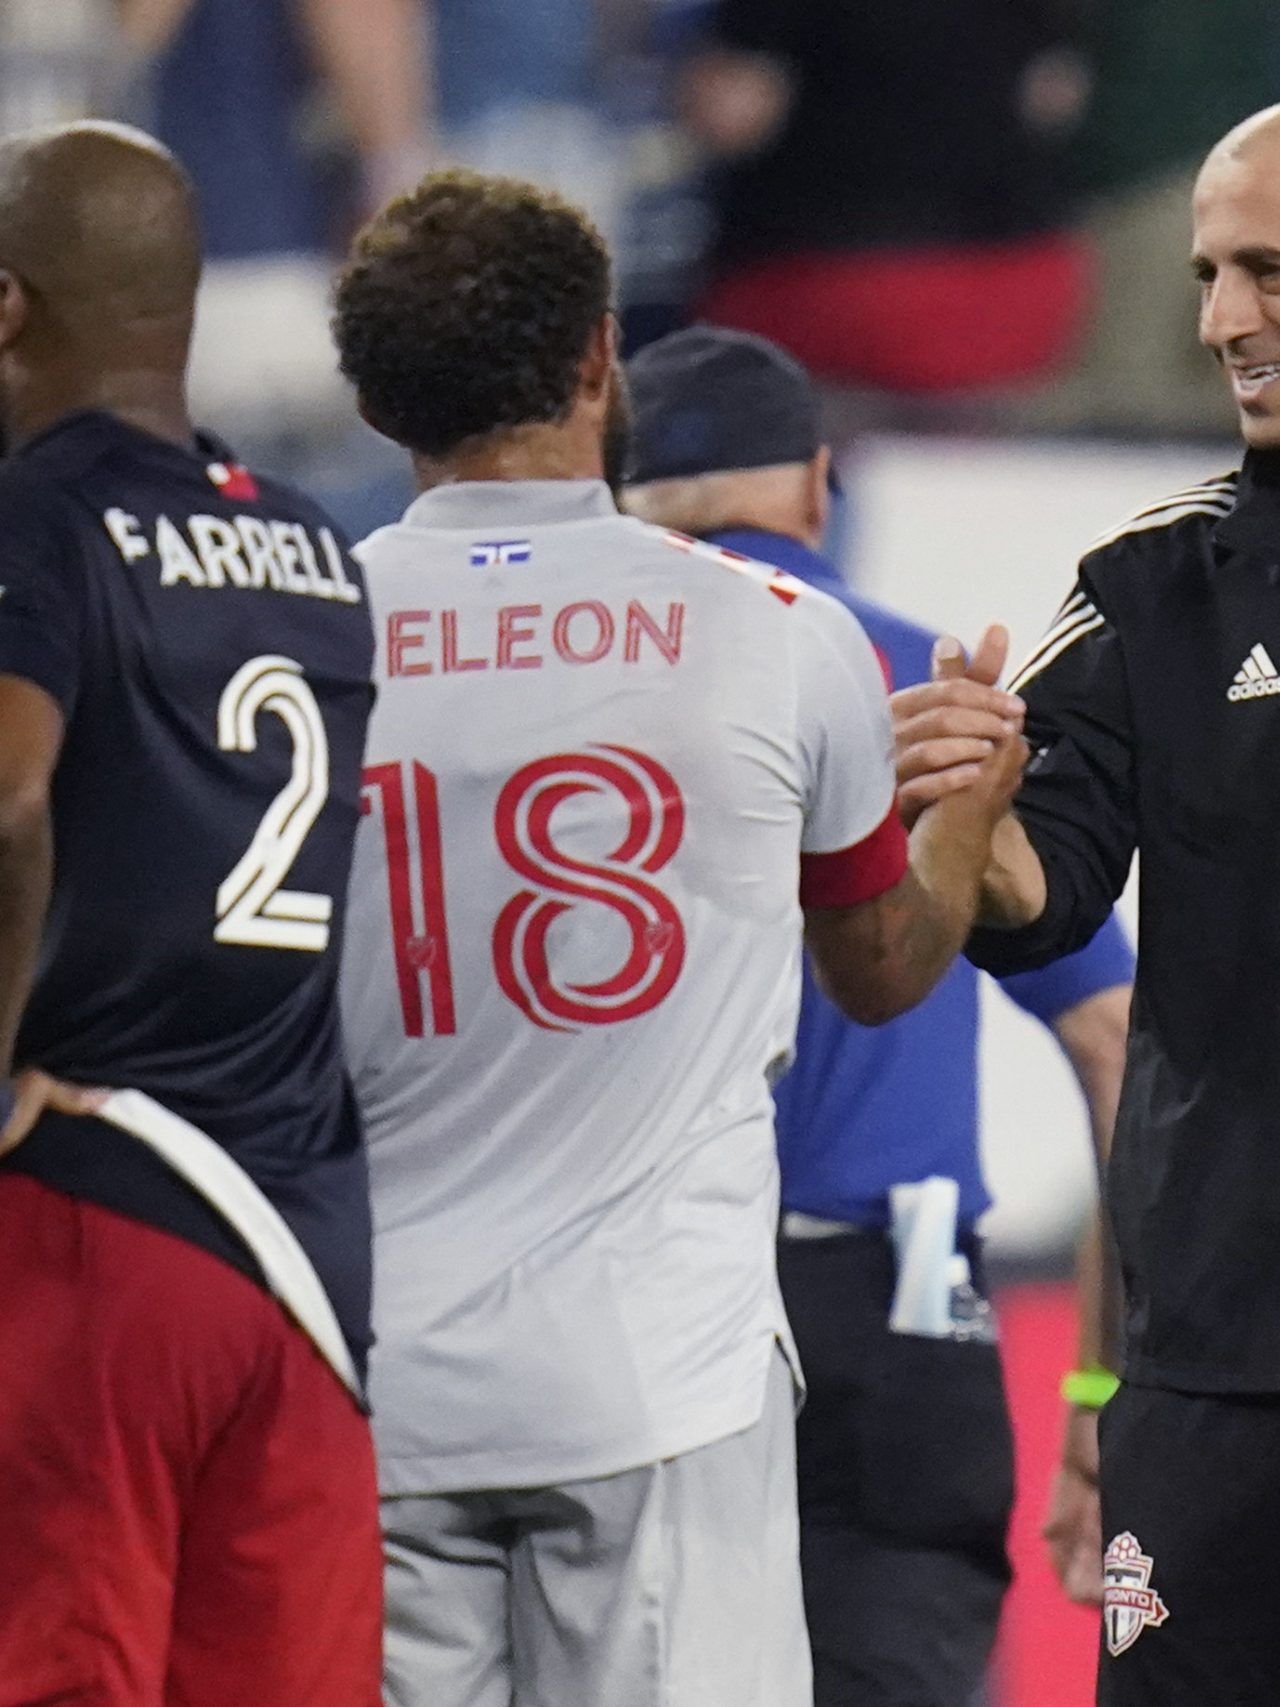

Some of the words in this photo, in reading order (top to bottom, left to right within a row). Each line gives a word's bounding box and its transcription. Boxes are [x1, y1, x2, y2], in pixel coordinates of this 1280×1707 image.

[103, 506, 361, 604] FARRELL
[212, 654, 332, 950] 2
[361, 741, 687, 1036] 18
